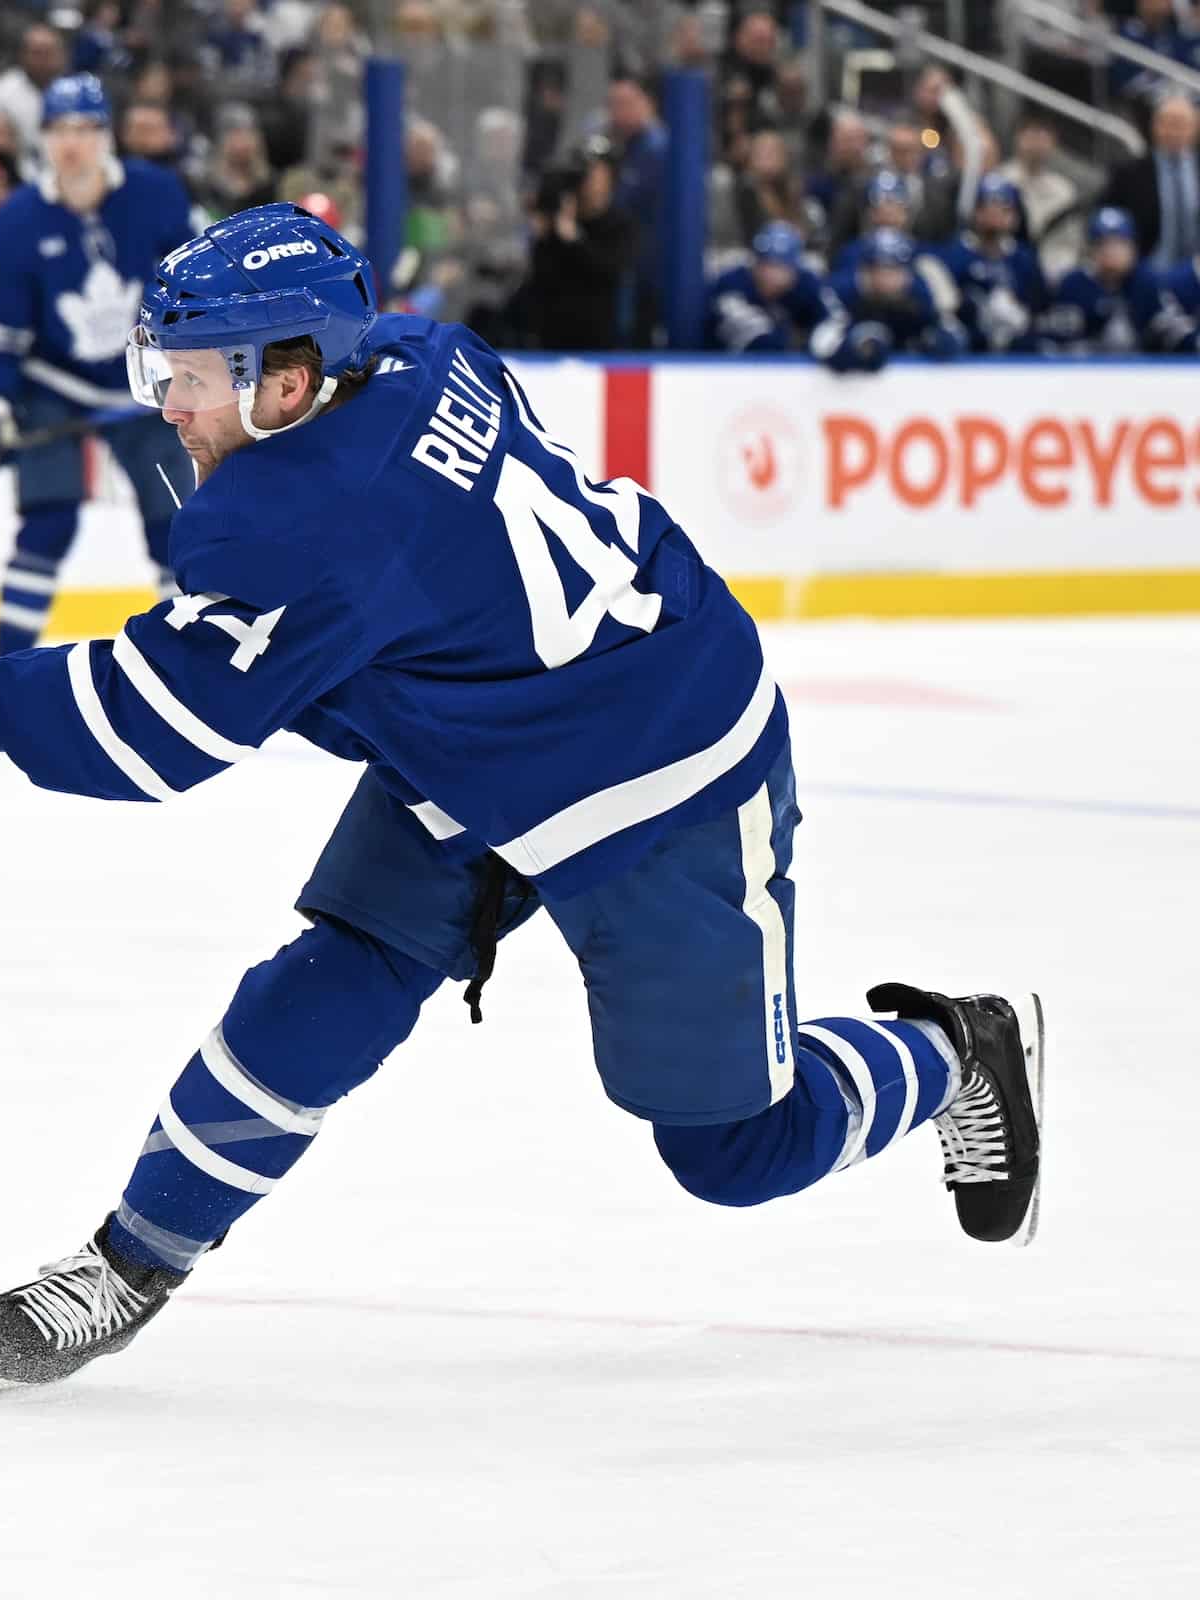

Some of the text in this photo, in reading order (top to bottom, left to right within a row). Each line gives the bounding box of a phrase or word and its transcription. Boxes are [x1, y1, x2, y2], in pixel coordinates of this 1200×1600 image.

[243, 239, 318, 270] OREO
[410, 347, 502, 492] RIELLY
[772, 993, 786, 1065] CCM
